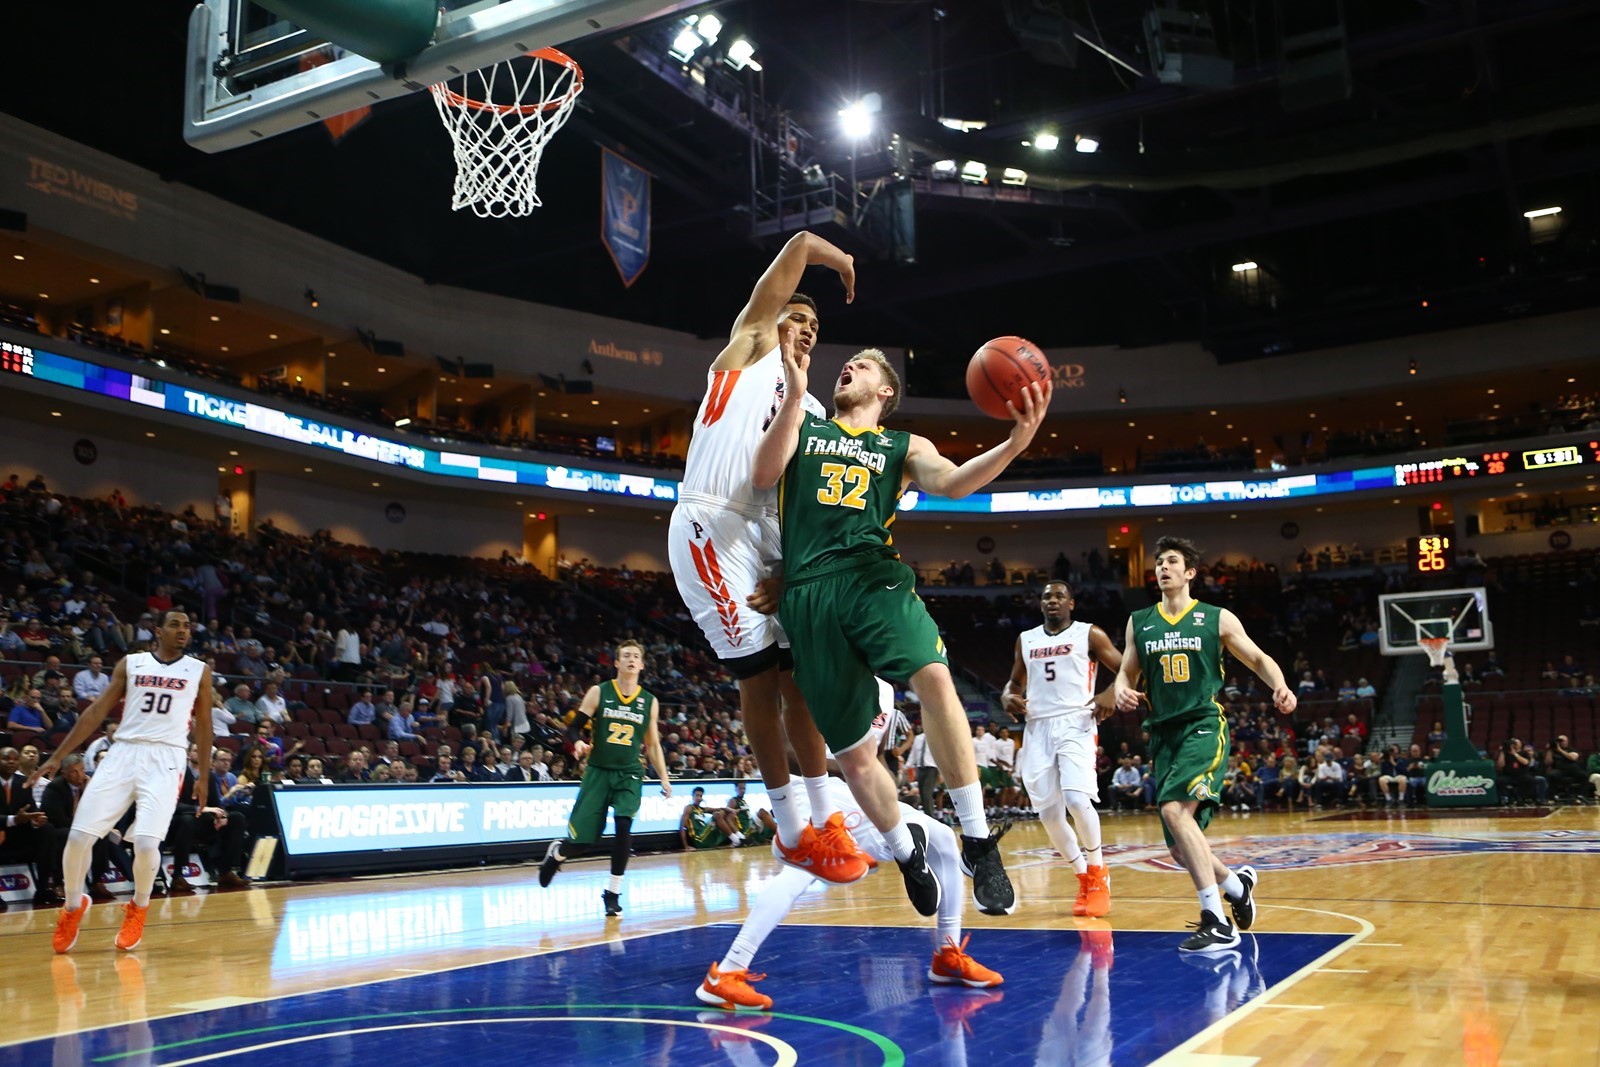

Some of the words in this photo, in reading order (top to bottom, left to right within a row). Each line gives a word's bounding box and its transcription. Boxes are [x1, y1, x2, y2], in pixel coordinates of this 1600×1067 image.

[27, 156, 69, 185] TED
[71, 168, 138, 212] WIENS
[588, 339, 637, 362] Anthem
[1051, 364, 1085, 378] YD
[184, 391, 258, 427] TICKET
[804, 436, 887, 474] FRANCISCO
[1487, 461, 1505, 474] 26
[817, 462, 871, 510] 32
[1419, 537, 1449, 551] 6:31
[1418, 550, 1445, 571] 26
[1145, 636, 1202, 655] FRANCISCO
[1164, 631, 1181, 640] SAN
[1029, 643, 1074, 660] WAVES
[1044, 661, 1057, 682] 5
[1159, 653, 1190, 684] 10
[134, 675, 188, 691] WAVES
[141, 692, 172, 714] 30
[606, 722, 635, 746] 22
[289, 801, 466, 841] PROGRESSIVE
